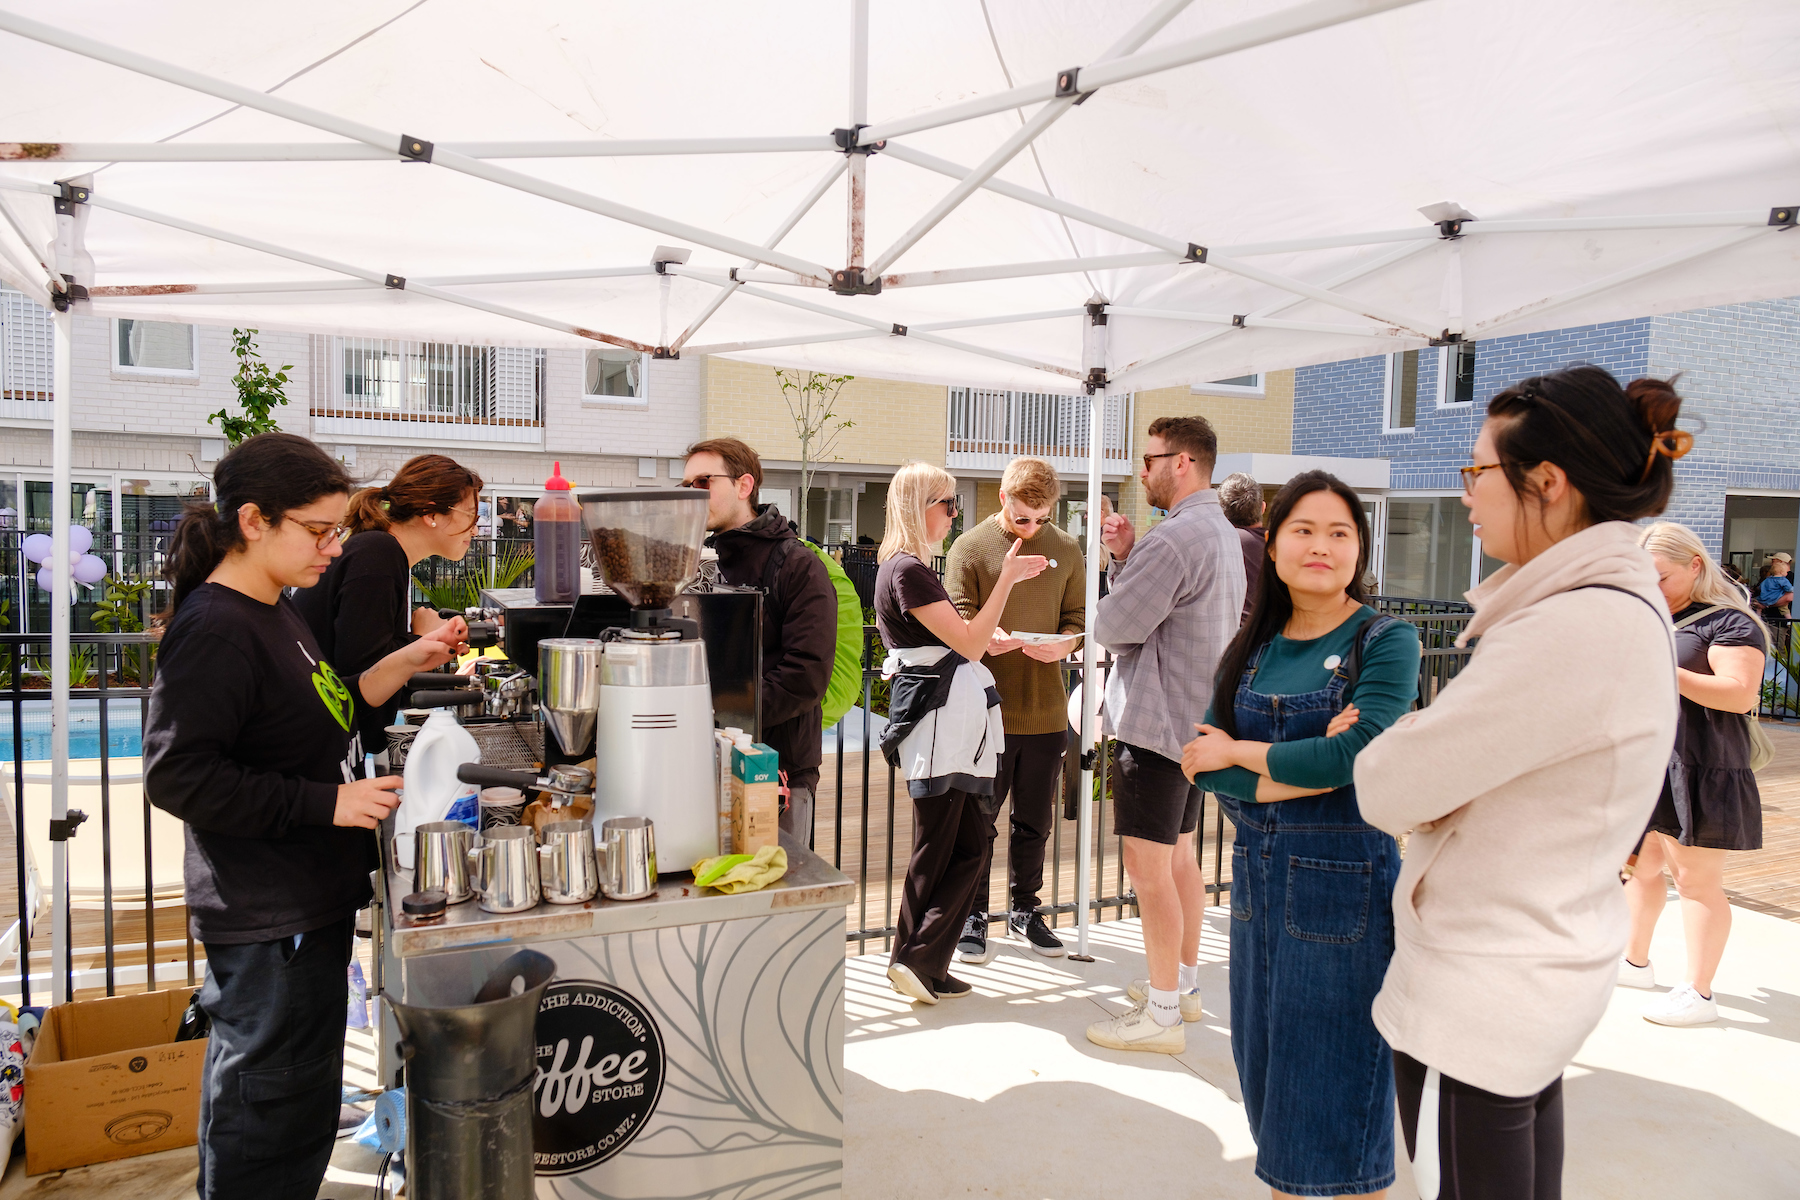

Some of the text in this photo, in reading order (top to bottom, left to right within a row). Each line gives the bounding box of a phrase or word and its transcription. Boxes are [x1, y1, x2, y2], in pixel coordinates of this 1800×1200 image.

[754, 773, 769, 781] SOY
[571, 992, 646, 1037] ADDICTION
[535, 1044, 553, 1057] HE
[592, 1082, 644, 1103] STORE
[533, 1117, 634, 1165] EESTORE.CO.NZ
